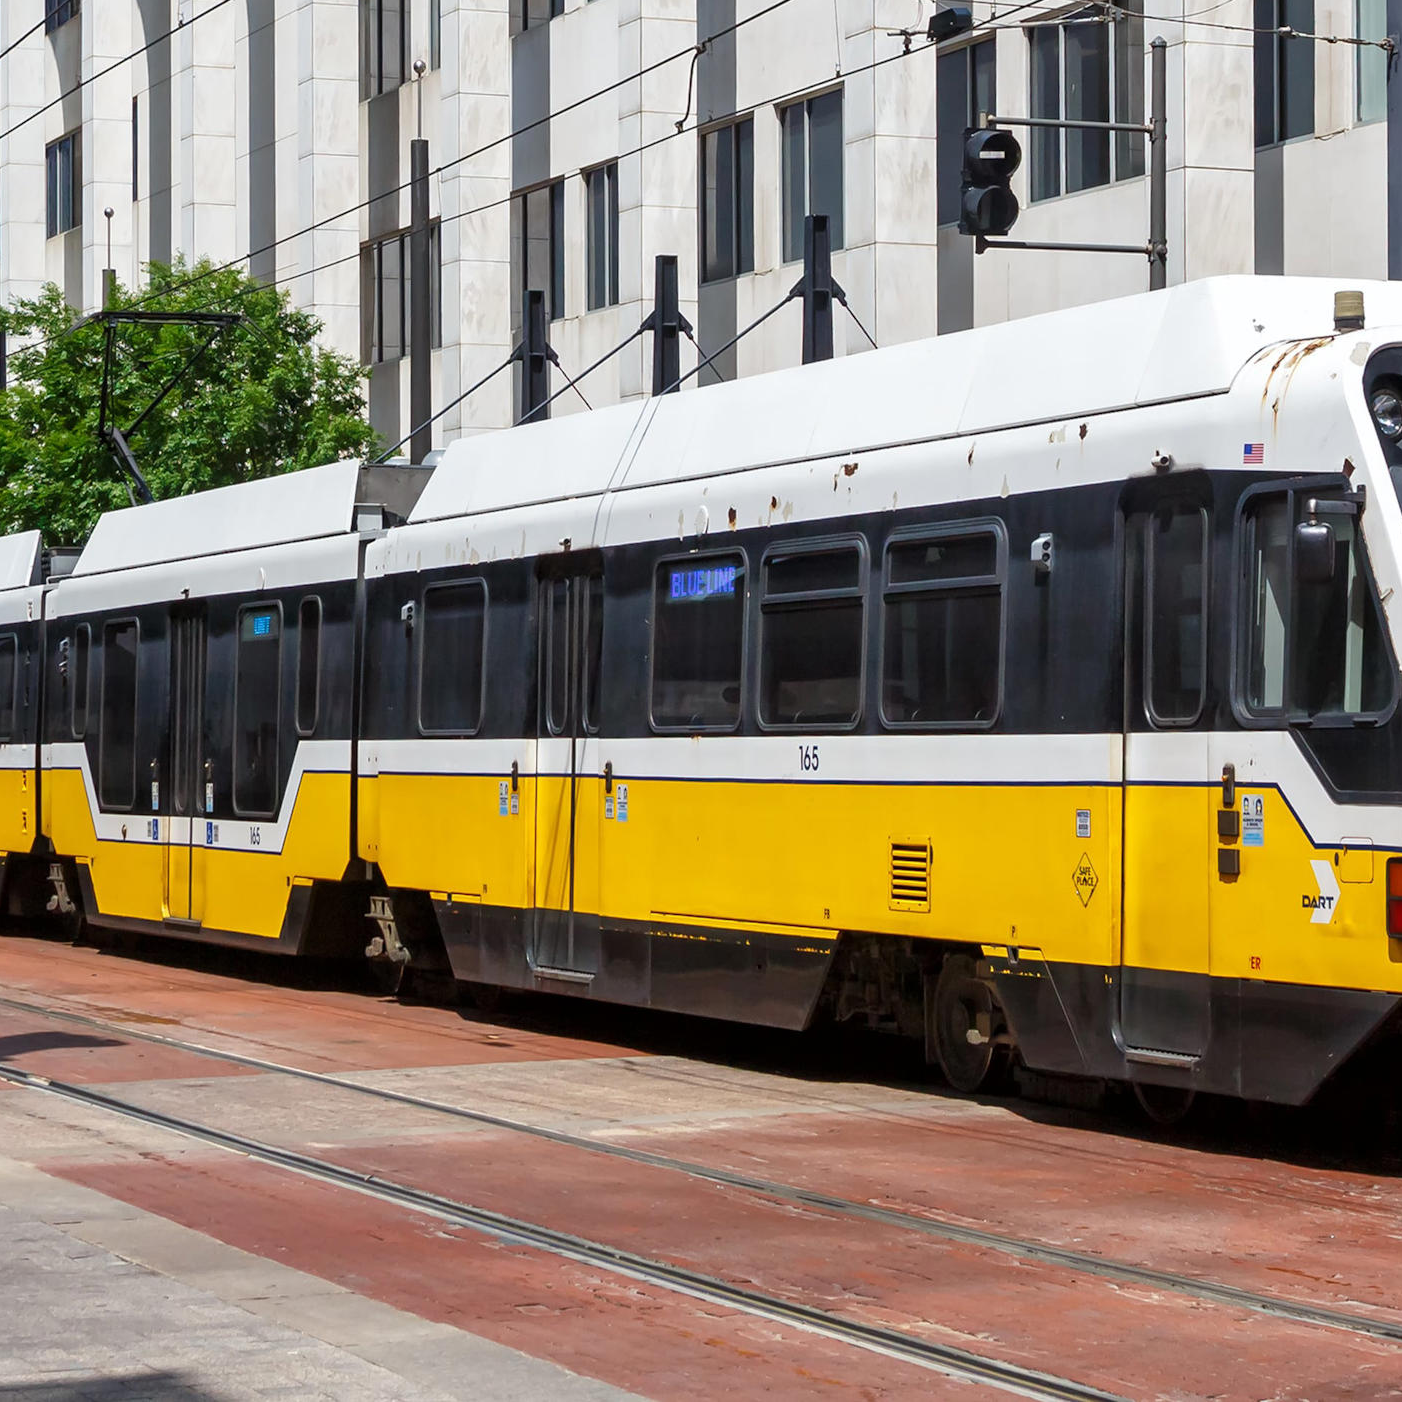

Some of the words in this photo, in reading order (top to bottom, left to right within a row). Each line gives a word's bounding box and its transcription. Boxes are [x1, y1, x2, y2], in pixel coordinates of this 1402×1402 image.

[671, 570, 704, 598] BLUE
[706, 566, 735, 594] LINE
[799, 746, 819, 771] 165
[249, 826, 261, 846] 165
[1079, 866, 1091, 876] SAFE
[1077, 876, 1094, 887] PLACE
[1302, 895, 1334, 909] DART
[1251, 956, 1261, 970] ER
